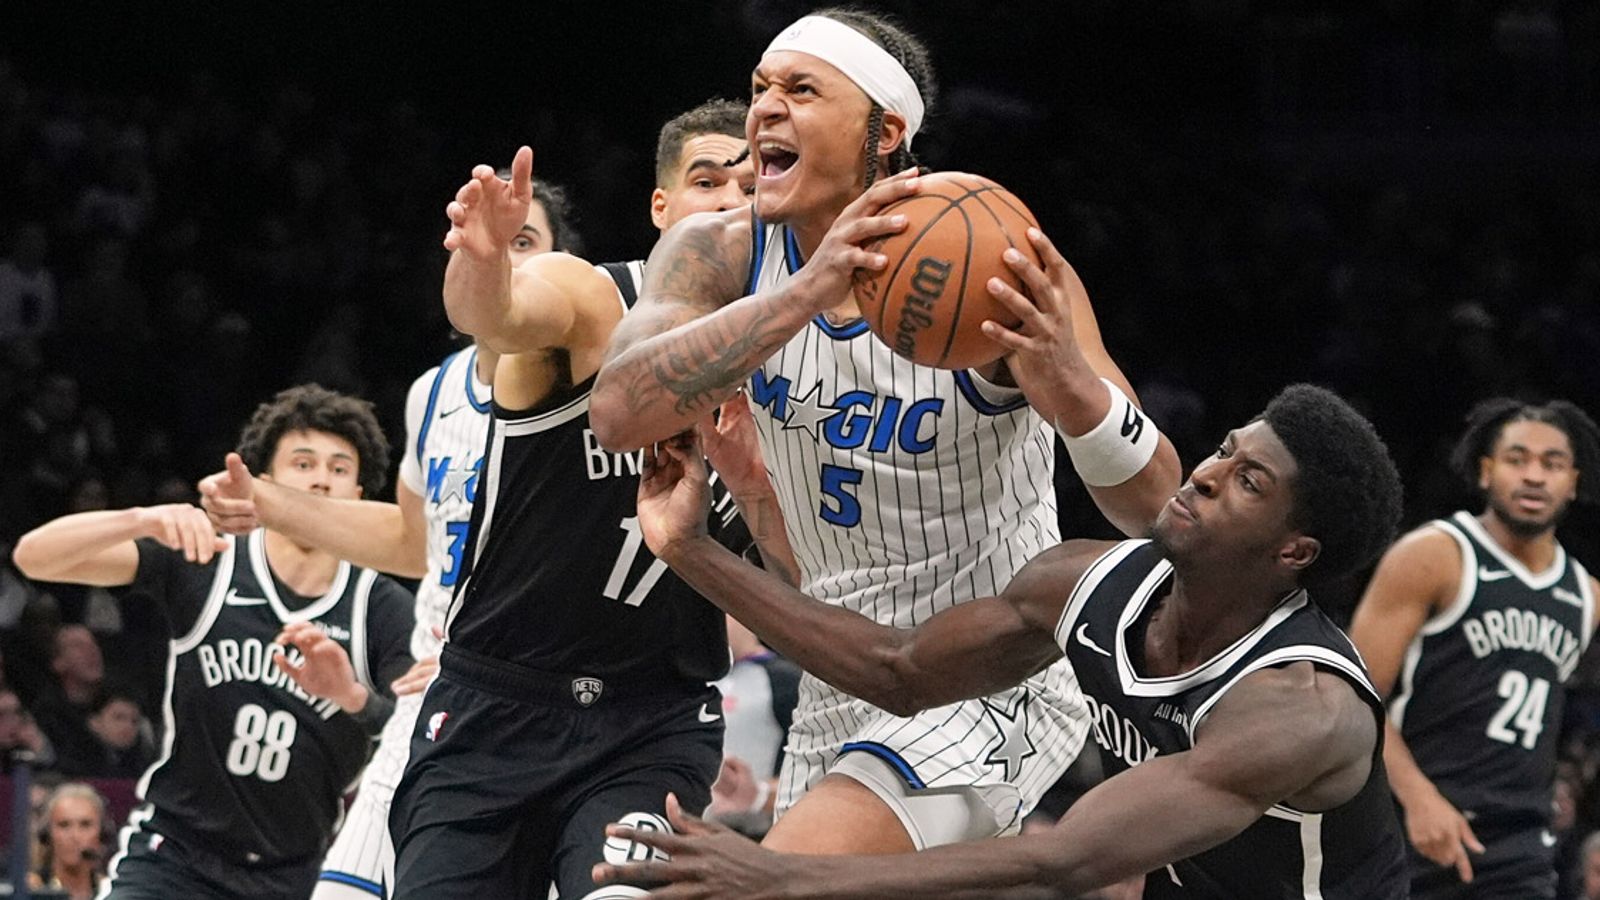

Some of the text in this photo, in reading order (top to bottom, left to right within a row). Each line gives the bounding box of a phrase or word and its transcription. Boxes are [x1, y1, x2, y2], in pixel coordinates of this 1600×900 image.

[895, 256, 952, 361] Wilson
[819, 463, 864, 528] 5
[199, 637, 342, 721] BROOK
[575, 681, 600, 692] NETS
[1154, 703, 1172, 719] All
[1486, 670, 1550, 750] 24
[226, 703, 298, 782] 88
